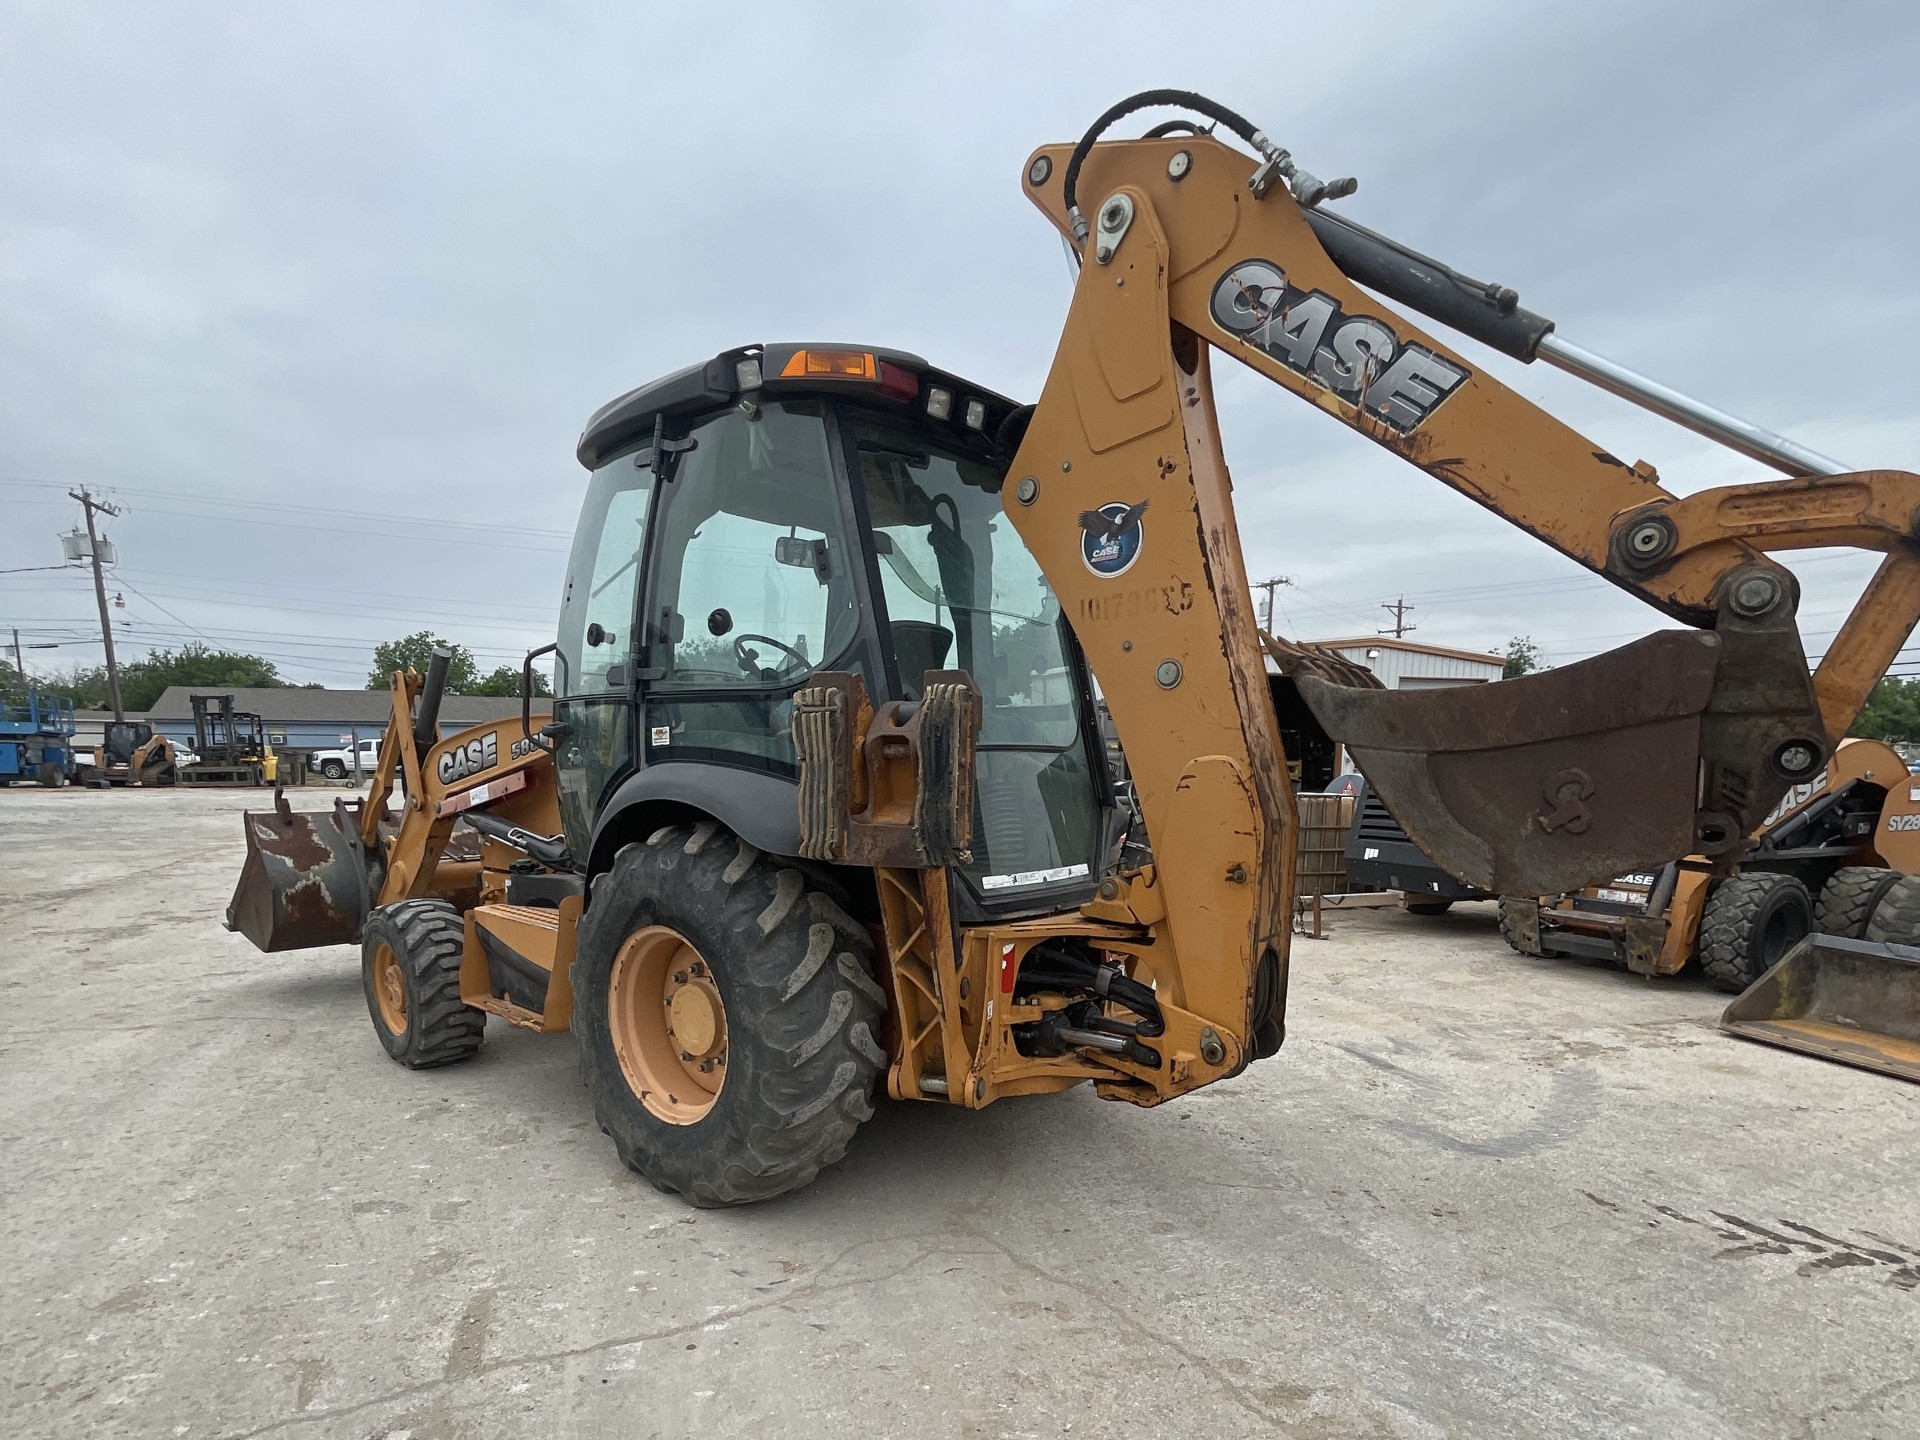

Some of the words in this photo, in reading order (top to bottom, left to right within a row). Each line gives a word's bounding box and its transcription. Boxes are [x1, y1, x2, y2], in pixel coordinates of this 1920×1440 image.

[1211, 259, 1471, 434] CASE
[1092, 545, 1120, 558] CASE
[438, 731, 498, 785] CASE
